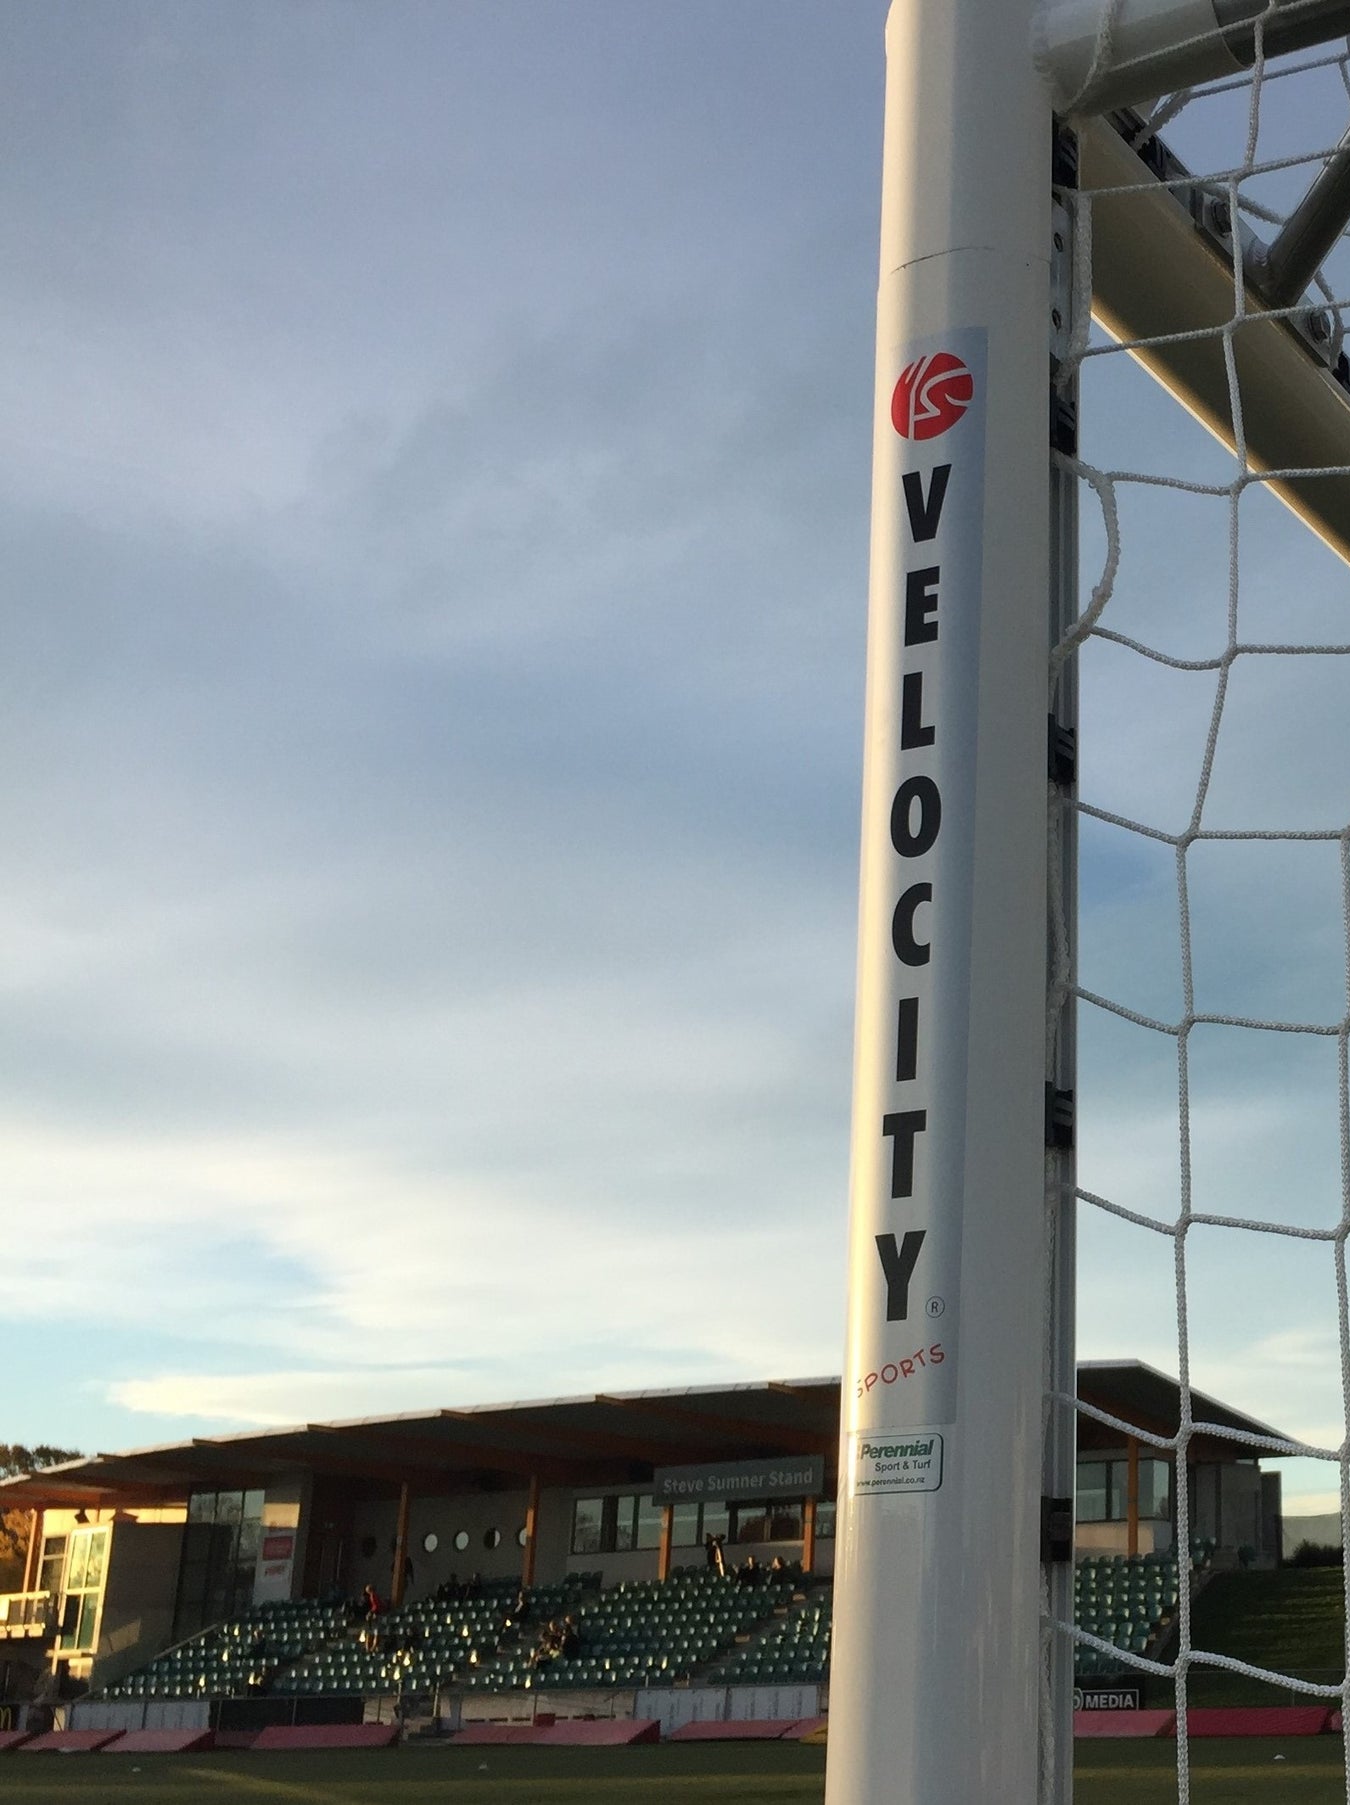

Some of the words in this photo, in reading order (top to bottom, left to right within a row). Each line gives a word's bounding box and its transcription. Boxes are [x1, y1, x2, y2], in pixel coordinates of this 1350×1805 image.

[875, 463, 953, 1321] VELOCITY
[861, 1439, 934, 1460] Perennial
[875, 1461, 900, 1474] Sport
[902, 1461, 909, 1470] &
[912, 1459, 931, 1470] Turf
[663, 1479, 704, 1494] Steve
[707, 1475, 766, 1491] Sumner
[768, 1467, 813, 1487] Stand
[1085, 1694, 1134, 1709] MEDIA
